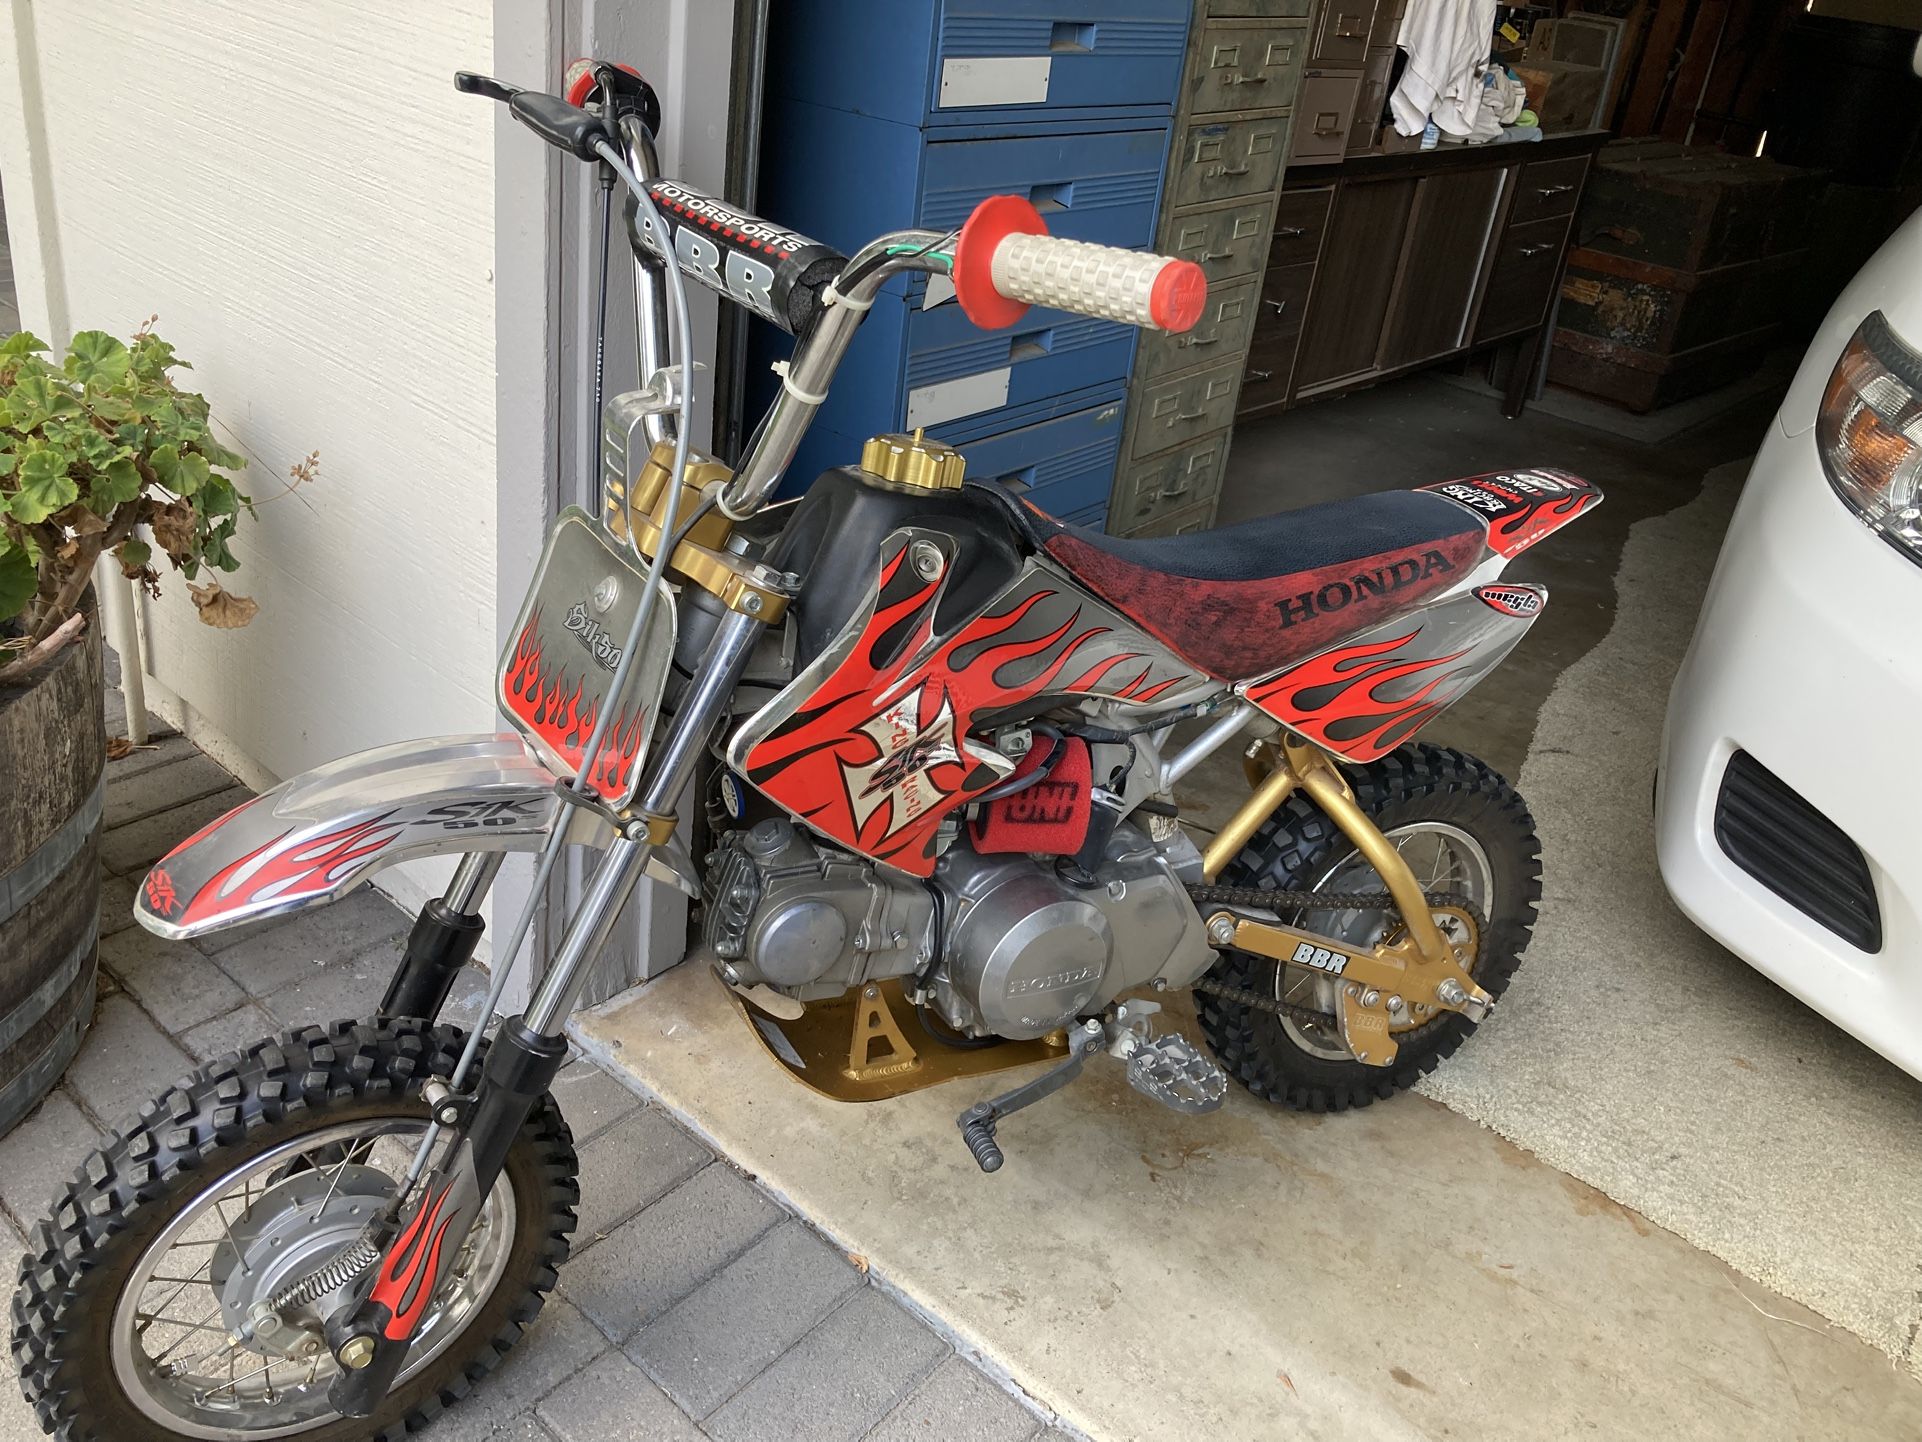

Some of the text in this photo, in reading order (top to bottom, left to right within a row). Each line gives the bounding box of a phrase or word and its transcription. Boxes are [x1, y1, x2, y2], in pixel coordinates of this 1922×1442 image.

[652, 182, 803, 252] MOTORSPORTS
[635, 203, 777, 319] BBR
[1442, 486, 1500, 512] KING
[1273, 550, 1456, 630] HONDA
[1009, 967, 1097, 994] HONDA
[1293, 942, 1347, 973] BBR
